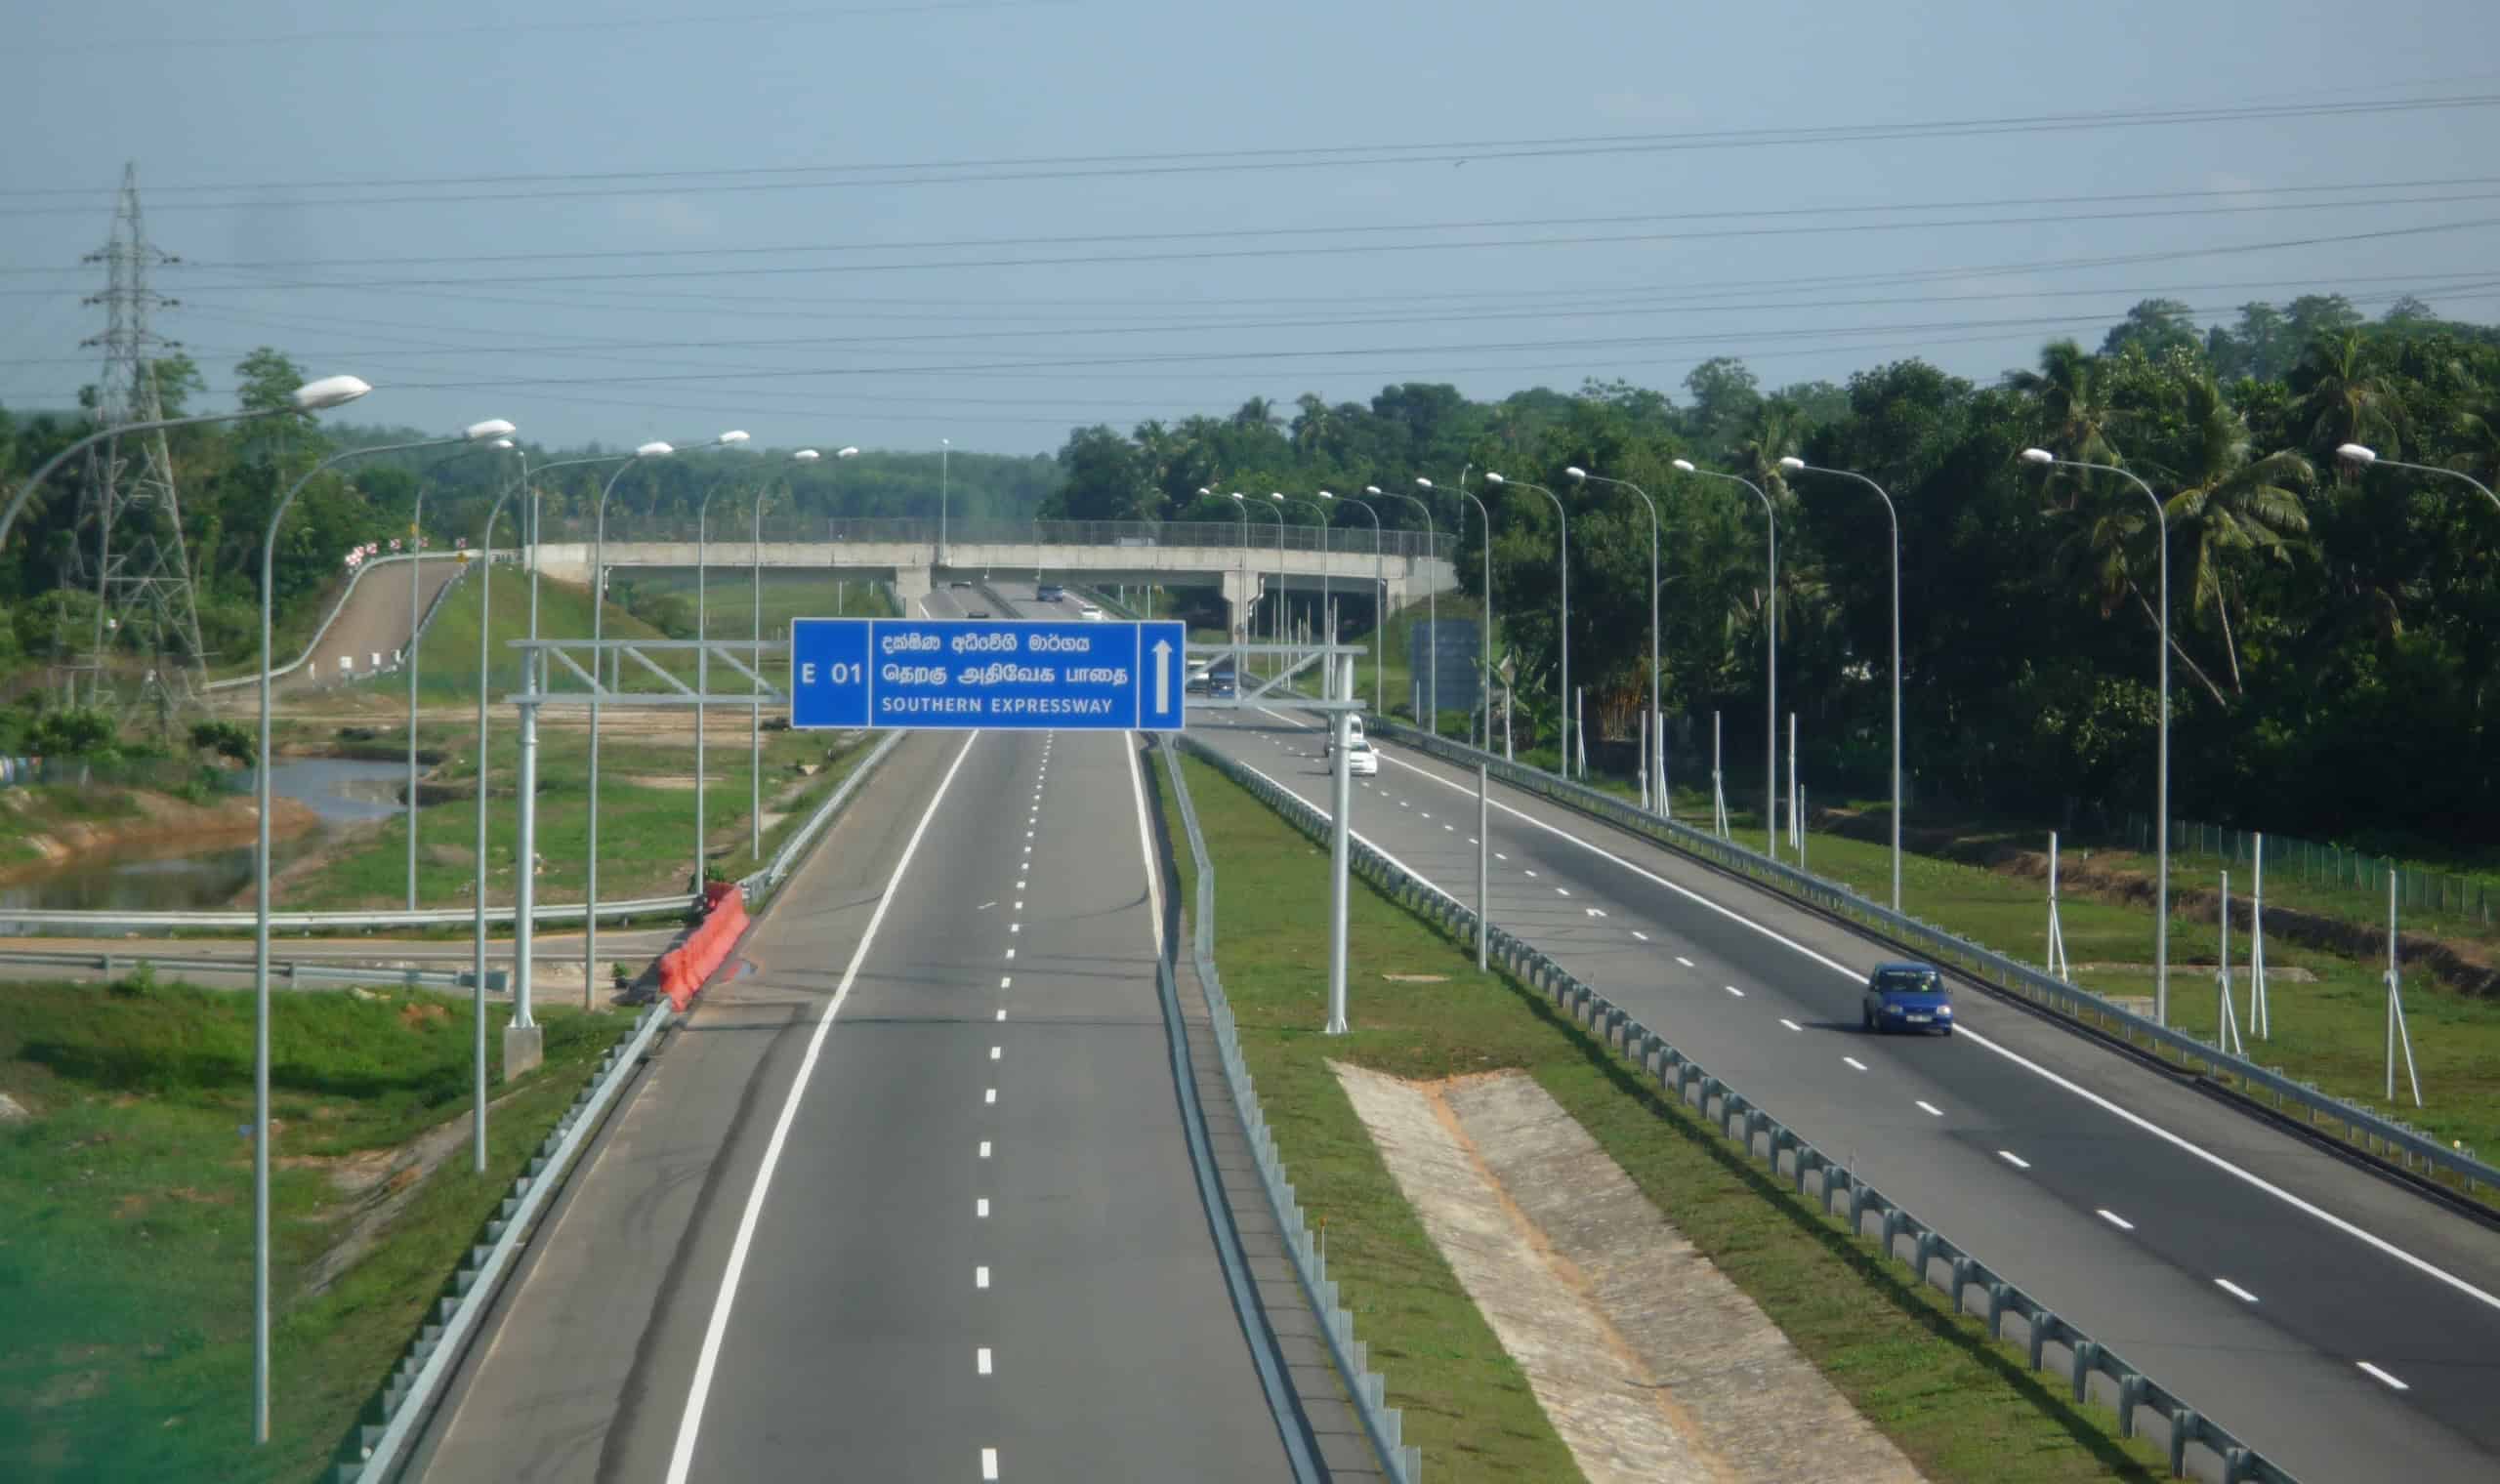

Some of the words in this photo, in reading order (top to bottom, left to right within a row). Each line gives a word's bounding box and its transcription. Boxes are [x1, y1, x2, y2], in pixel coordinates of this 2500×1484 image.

[802, 663, 816, 684] E
[830, 663, 861, 684] 01
[1065, 667, 1129, 686] பாதை
[882, 697, 982, 712] SOUTHERN
[991, 698, 1113, 714] EXPRESSWAY
